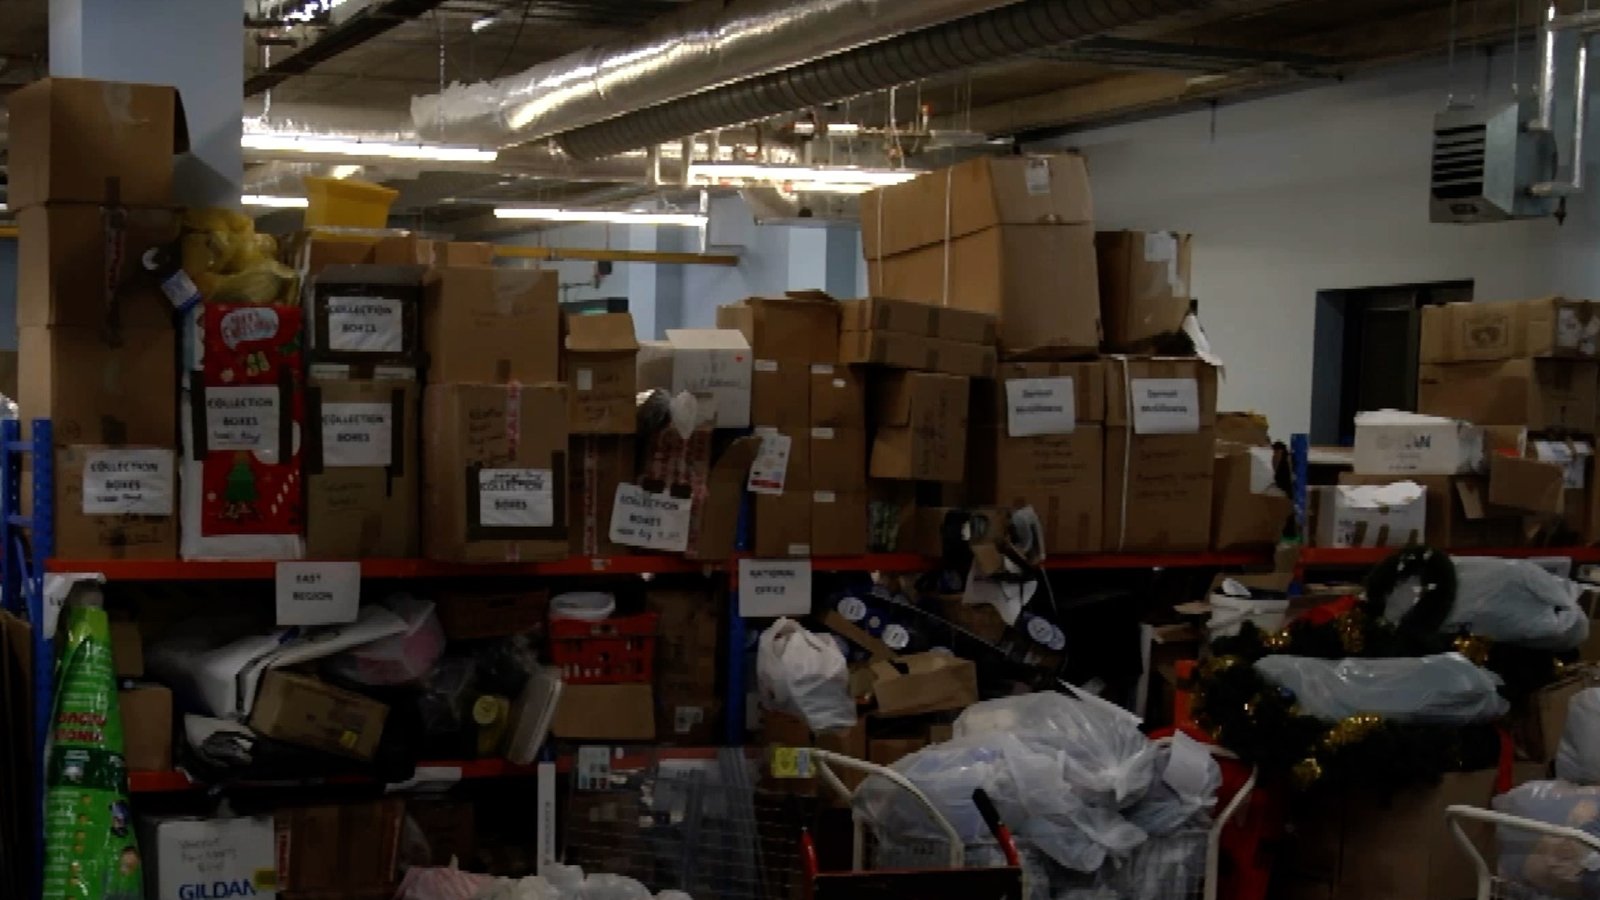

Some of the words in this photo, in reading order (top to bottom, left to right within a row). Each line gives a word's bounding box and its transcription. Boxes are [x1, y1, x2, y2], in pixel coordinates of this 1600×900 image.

[207, 397, 273, 408] COLLECTION
[223, 416, 258, 426] BOXES
[321, 413, 384, 425] COLLECTION
[337, 432, 370, 442] BOXES
[90, 460, 158, 472] COLLECTION
[105, 479, 141, 491] BOXES
[749, 568, 796, 578] NATIONAL
[295, 573, 321, 584] EAST
[754, 585, 786, 595] OFFICE
[292, 591, 334, 601] REGION
